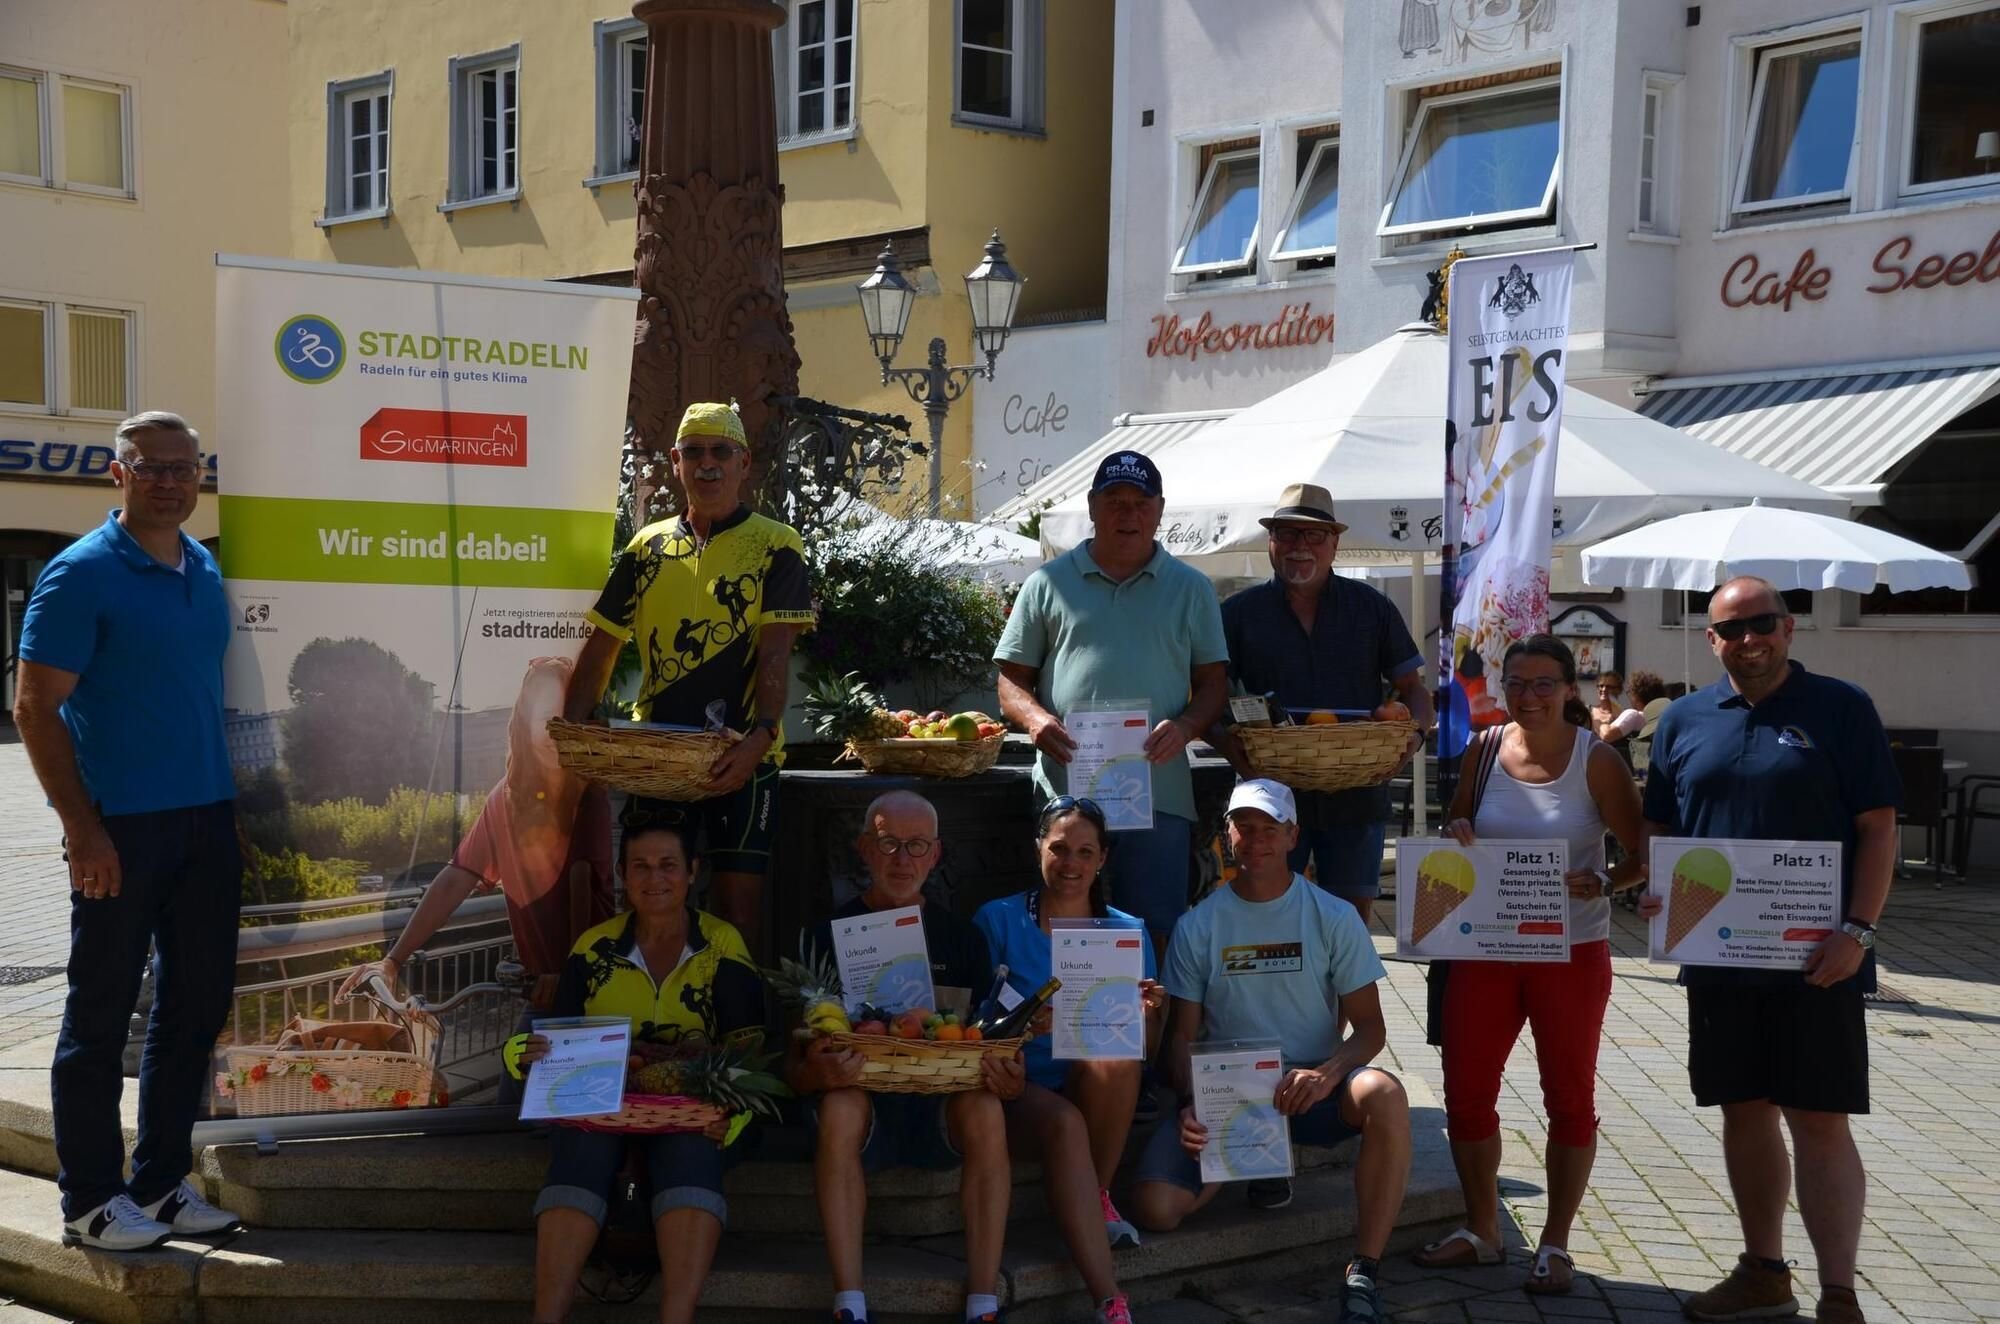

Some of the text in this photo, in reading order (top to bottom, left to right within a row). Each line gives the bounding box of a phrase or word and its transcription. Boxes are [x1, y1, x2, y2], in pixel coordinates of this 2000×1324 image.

[1721, 248, 1831, 312] Cafe
[358, 331, 588, 370] STADTRADELN
[360, 363, 528, 384] Radeln für ein gutes Klima
[1469, 349, 1562, 427] EIS
[1004, 391, 1069, 437] Cafe
[370, 430, 514, 457] SIGMARINGEN
[1105, 464, 1149, 479] PRAHA
[318, 528, 547, 562] Wir sind dabei!
[483, 609, 506, 617] Jetzt
[508, 609, 555, 619] registrieren
[482, 620, 592, 640] stadtradeln.de
[1507, 851, 1560, 864] Platz 1:
[1773, 853, 1832, 868] Platz 1:
[1503, 868, 1550, 877] Gesamtsieg
[1500, 879, 1560, 889] Bestes privates
[1498, 889, 1561, 898] (Vereins-) Team
[1506, 902, 1561, 911] Gutschein für
[1771, 902, 1832, 911] Gutschein für
[1497, 913, 1562, 923] Einen Eiswagen!
[1759, 913, 1832, 923] einen Eiswagen!
[845, 946, 877, 958] Urkunde
[1060, 961, 1093, 970] Urkunde
[1201, 1085, 1234, 1095] Urkunde
